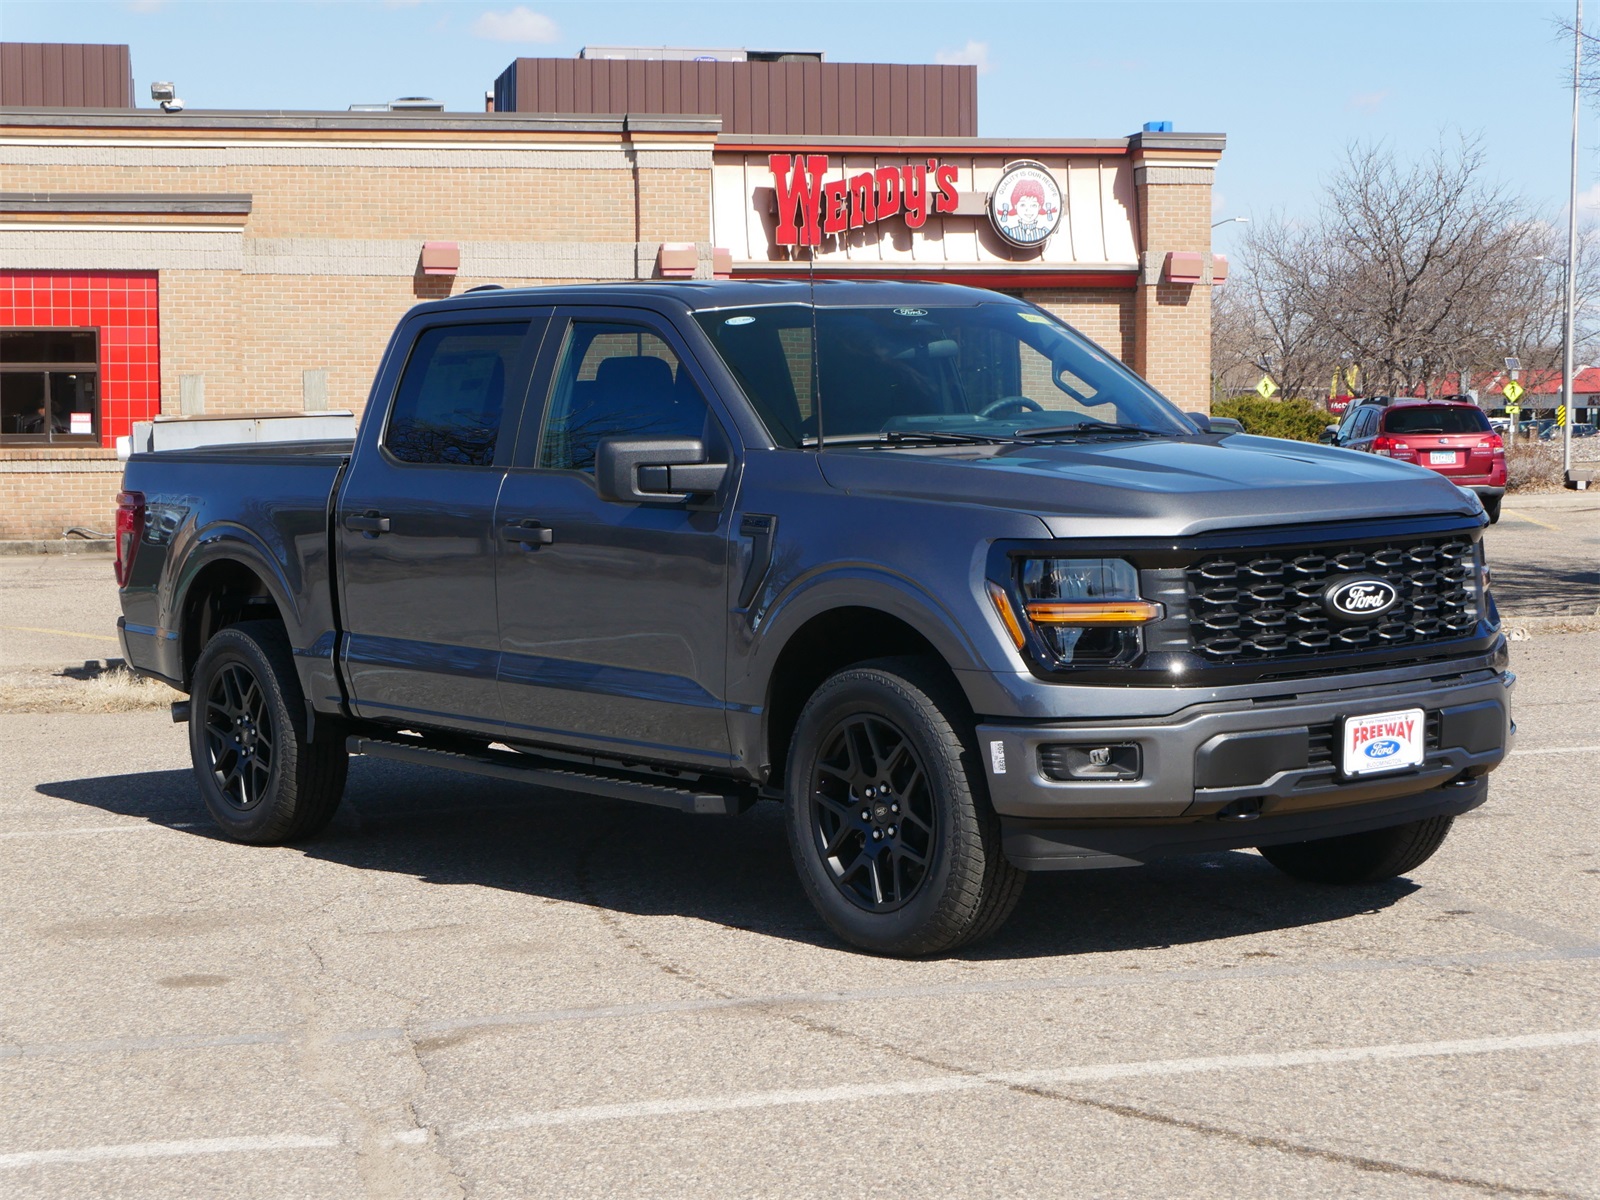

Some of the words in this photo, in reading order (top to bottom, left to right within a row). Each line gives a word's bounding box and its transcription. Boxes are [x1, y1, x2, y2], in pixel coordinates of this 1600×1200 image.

[999, 173, 1019, 195] QUALITY
[1027, 171, 1042, 179] OUR
[1042, 176, 1058, 197] RECIPE
[1345, 585, 1385, 610] Ford
[1352, 720, 1415, 754] FREEWAY
[1370, 741, 1395, 757] Ford
[1366, 758, 1402, 769] BLOOMINGTON
